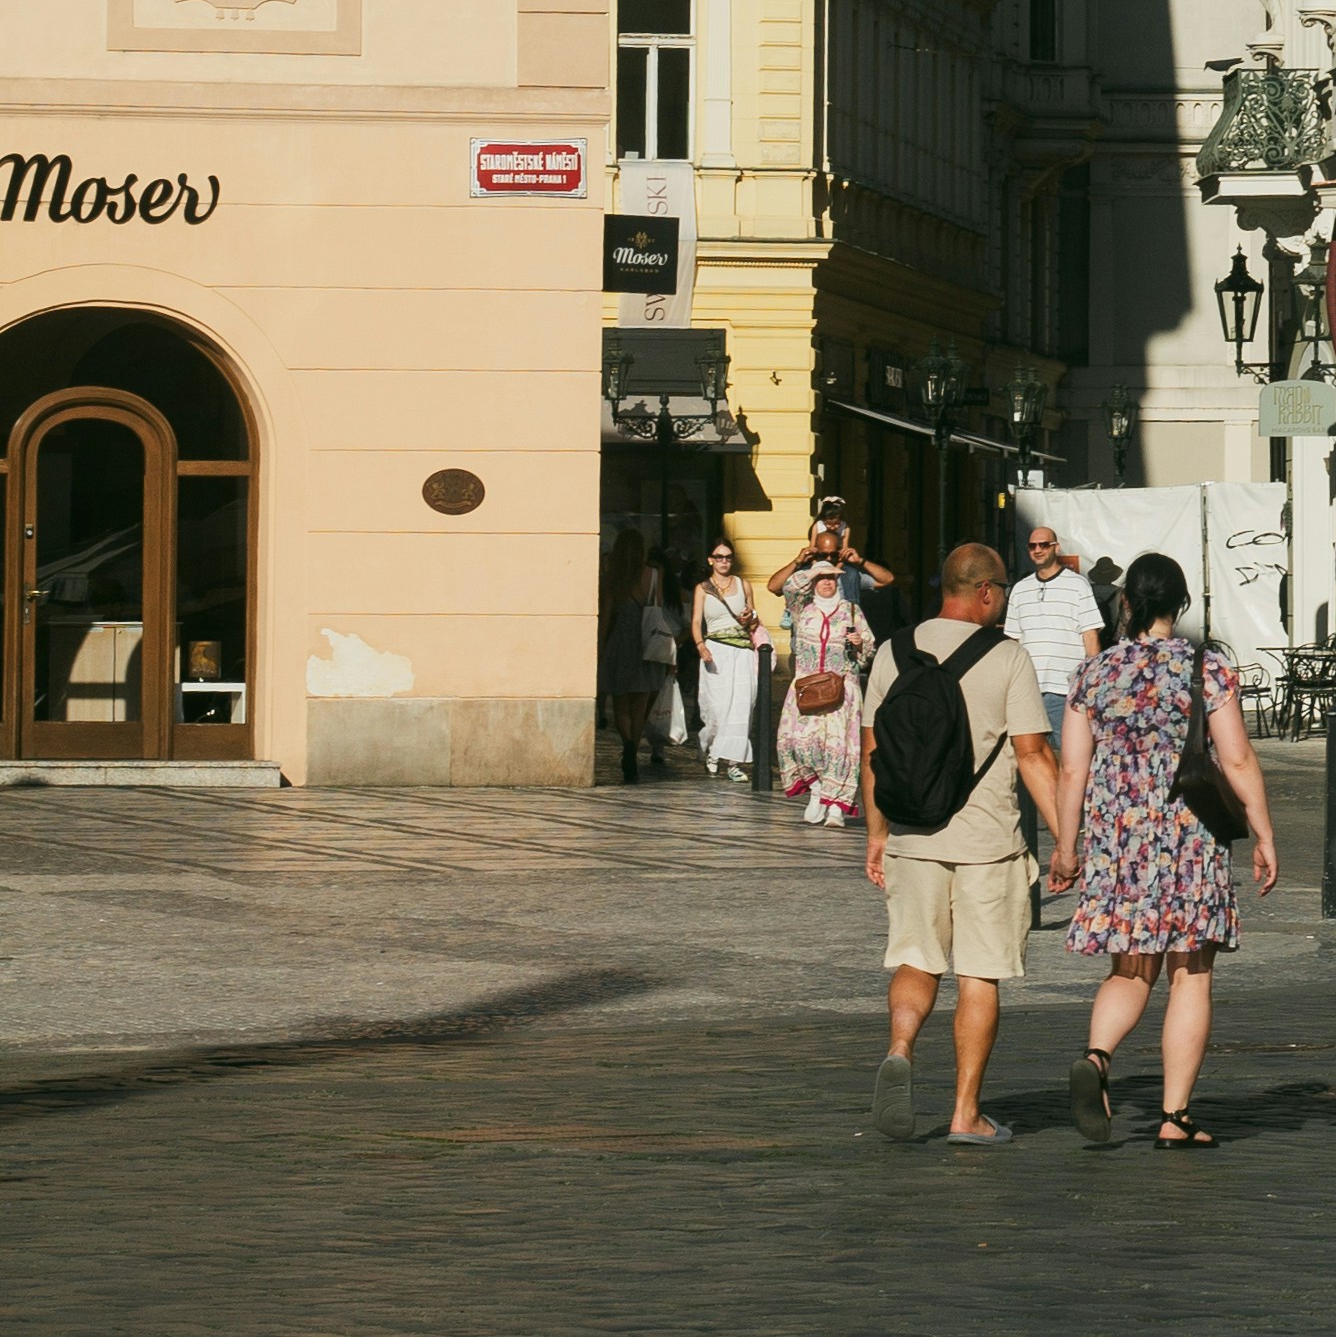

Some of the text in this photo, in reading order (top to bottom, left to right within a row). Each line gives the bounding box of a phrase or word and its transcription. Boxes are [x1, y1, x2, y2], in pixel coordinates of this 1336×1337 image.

[480, 151, 579, 170] STAROMĚSTSKÉ NÁMĚSTÍ
[492, 172, 514, 184] STARÉ
[562, 174, 567, 184] 1
[0, 152, 220, 225] Moser
[612, 247, 668, 266] Moser
